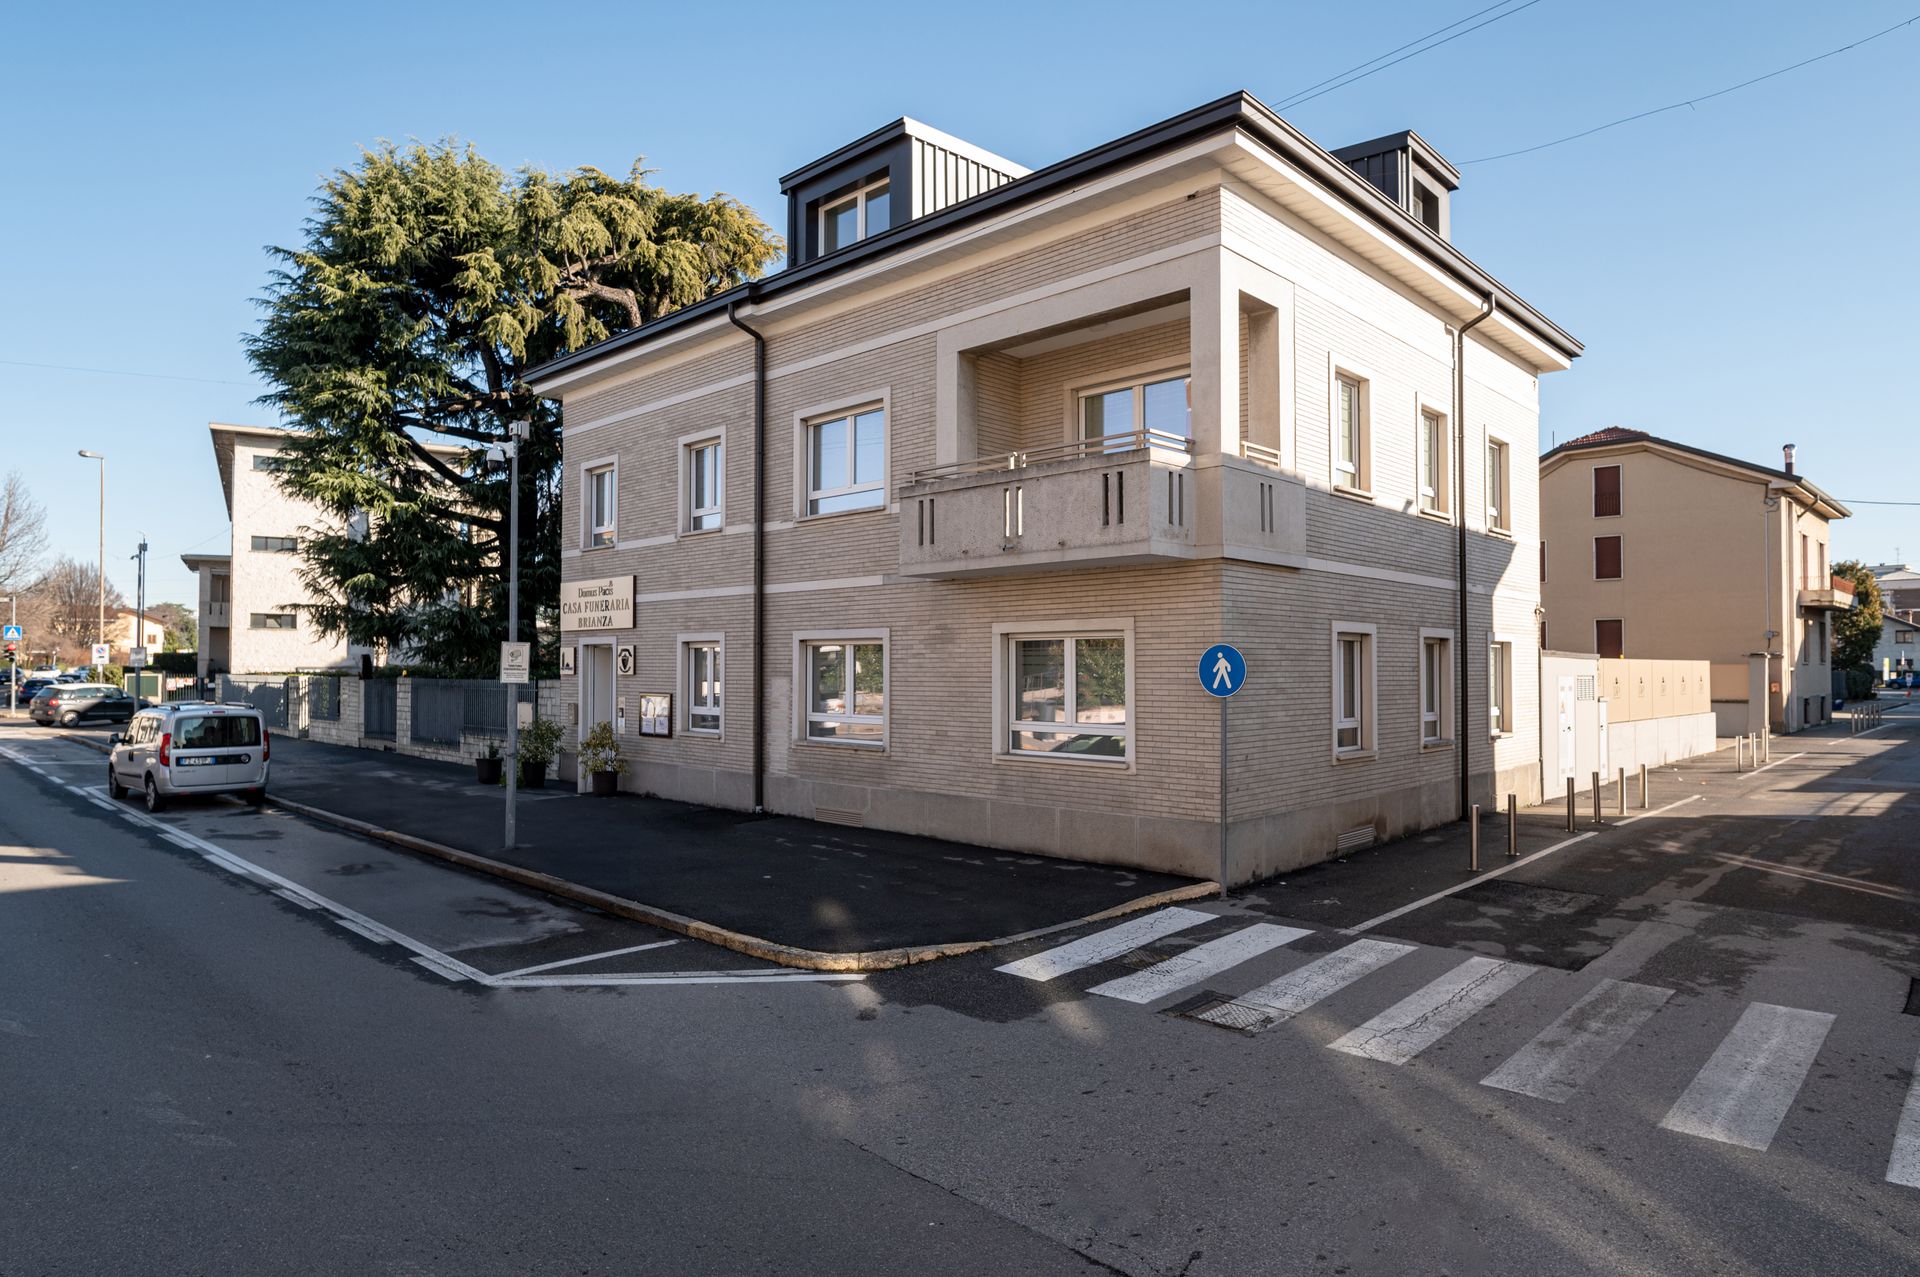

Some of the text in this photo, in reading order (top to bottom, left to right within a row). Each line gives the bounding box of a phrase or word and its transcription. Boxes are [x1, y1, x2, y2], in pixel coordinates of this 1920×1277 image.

[578, 586, 614, 598] Domus Pacis
[562, 598, 630, 614] CASA FUNERARIA
[578, 615, 613, 628] BRIANZA
